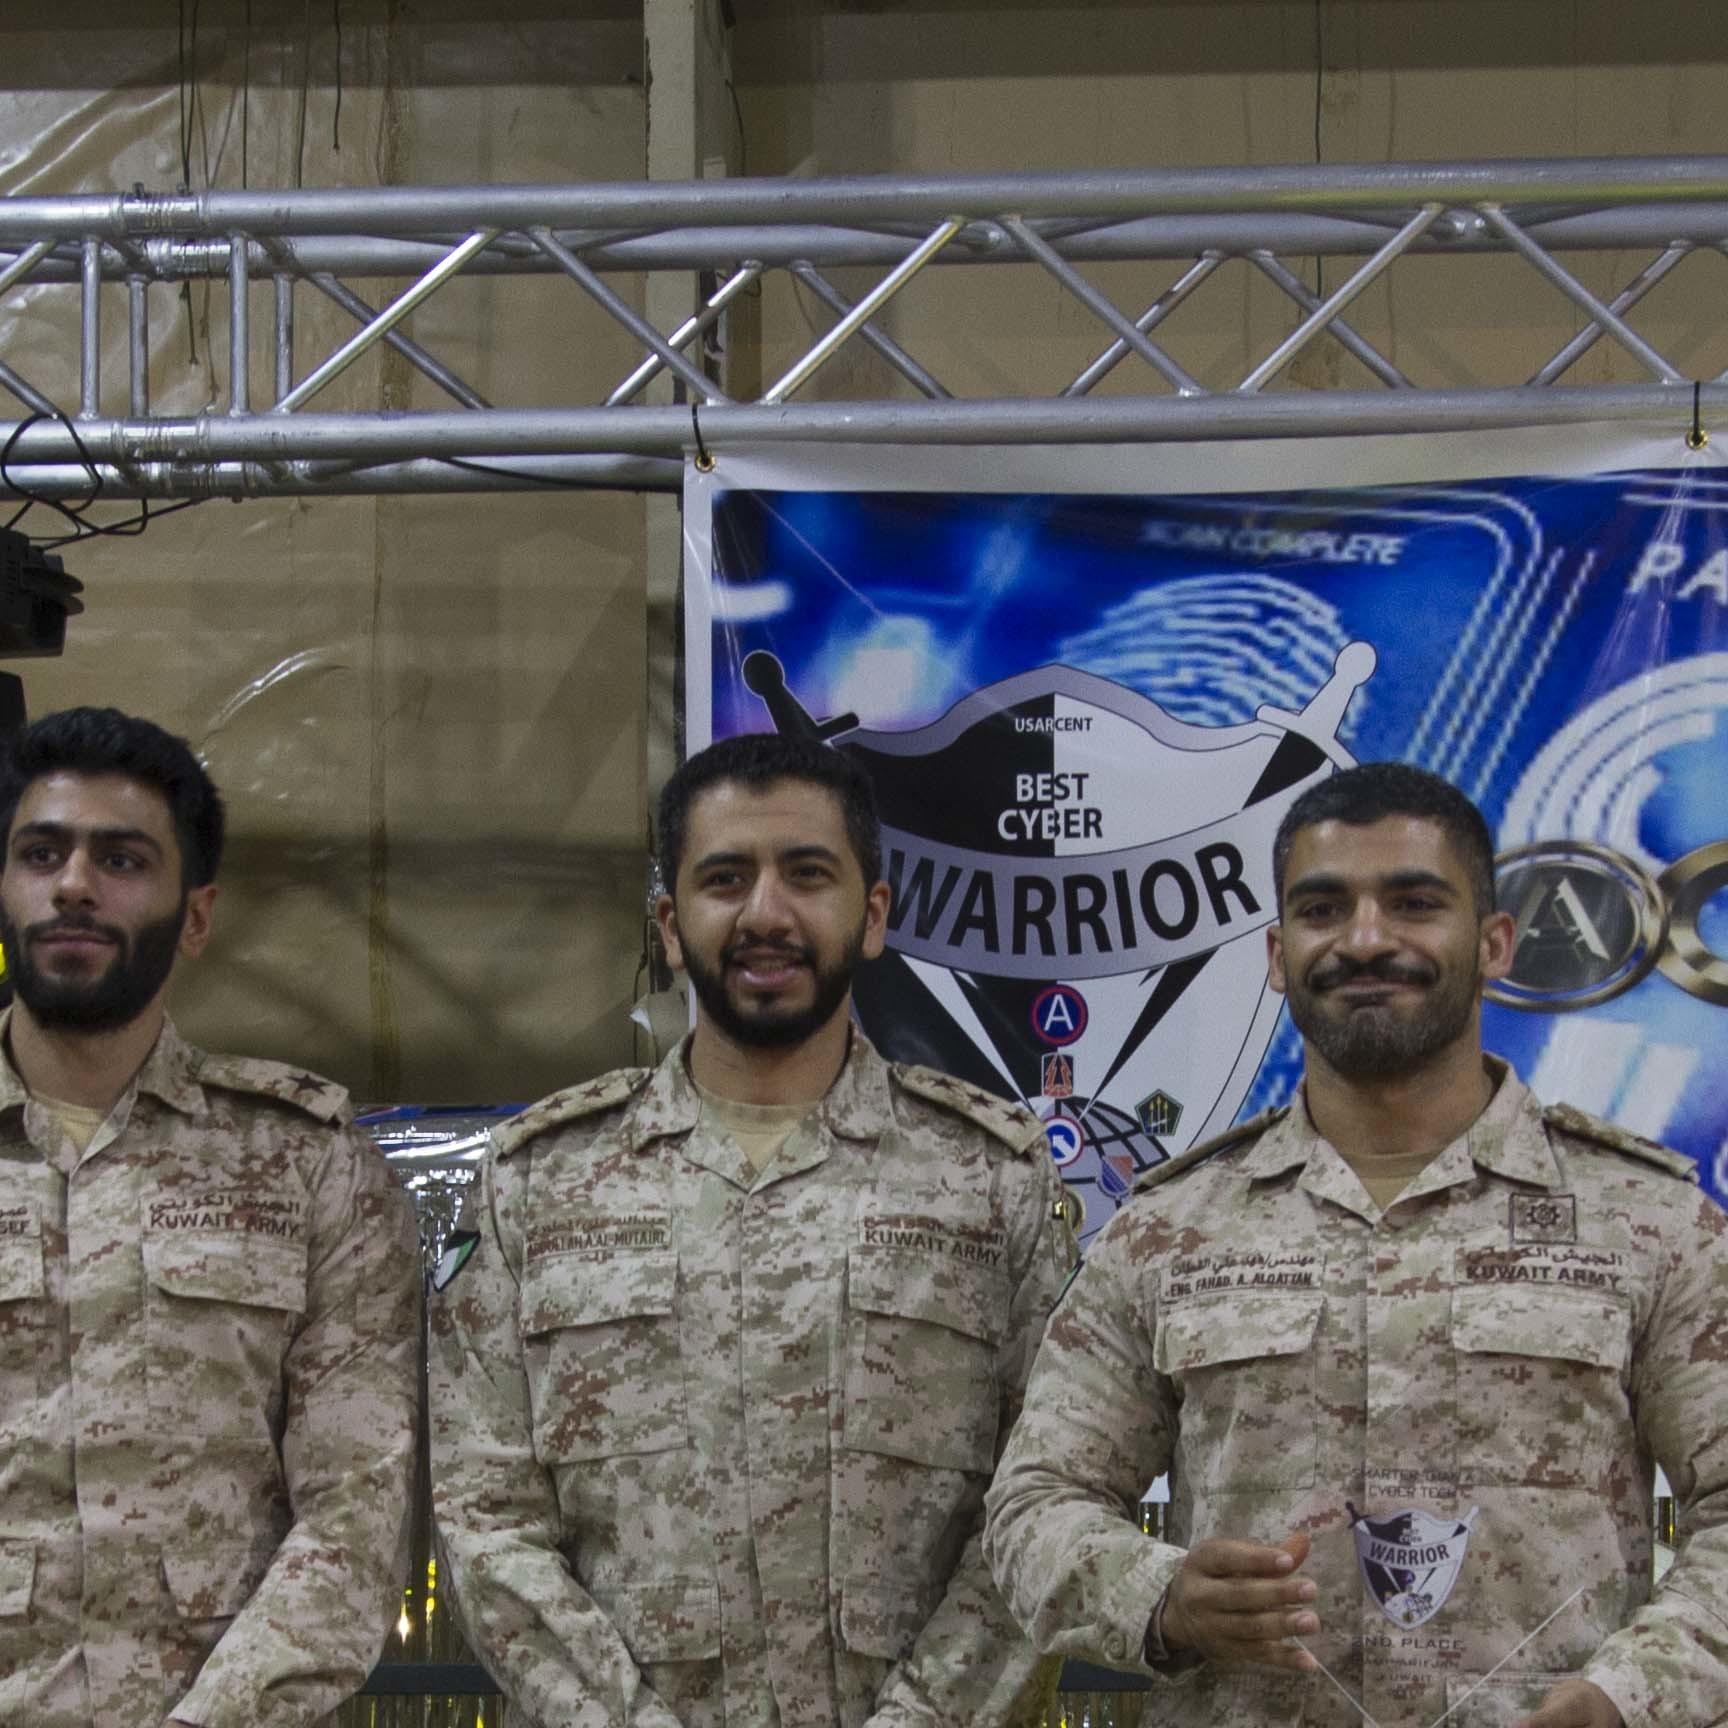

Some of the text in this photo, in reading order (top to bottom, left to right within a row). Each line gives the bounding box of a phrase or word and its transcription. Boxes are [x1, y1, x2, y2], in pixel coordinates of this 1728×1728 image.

[1014, 717, 1093, 733] USARCENT
[1015, 772, 1090, 802] BEST
[997, 807, 1104, 841] CYBER
[885, 841, 1262, 957] WARRIOR
[150, 1211, 300, 1239] KUWAIT ARMY
[864, 1229, 947, 1252] KUWAIT
[951, 1240, 1002, 1266] ARMY
[1465, 1265, 1623, 1291] KUWAIT ARMY
[1370, 1541, 1451, 1566] WARRIOR
[1401, 1637, 1464, 1650] PLACE
